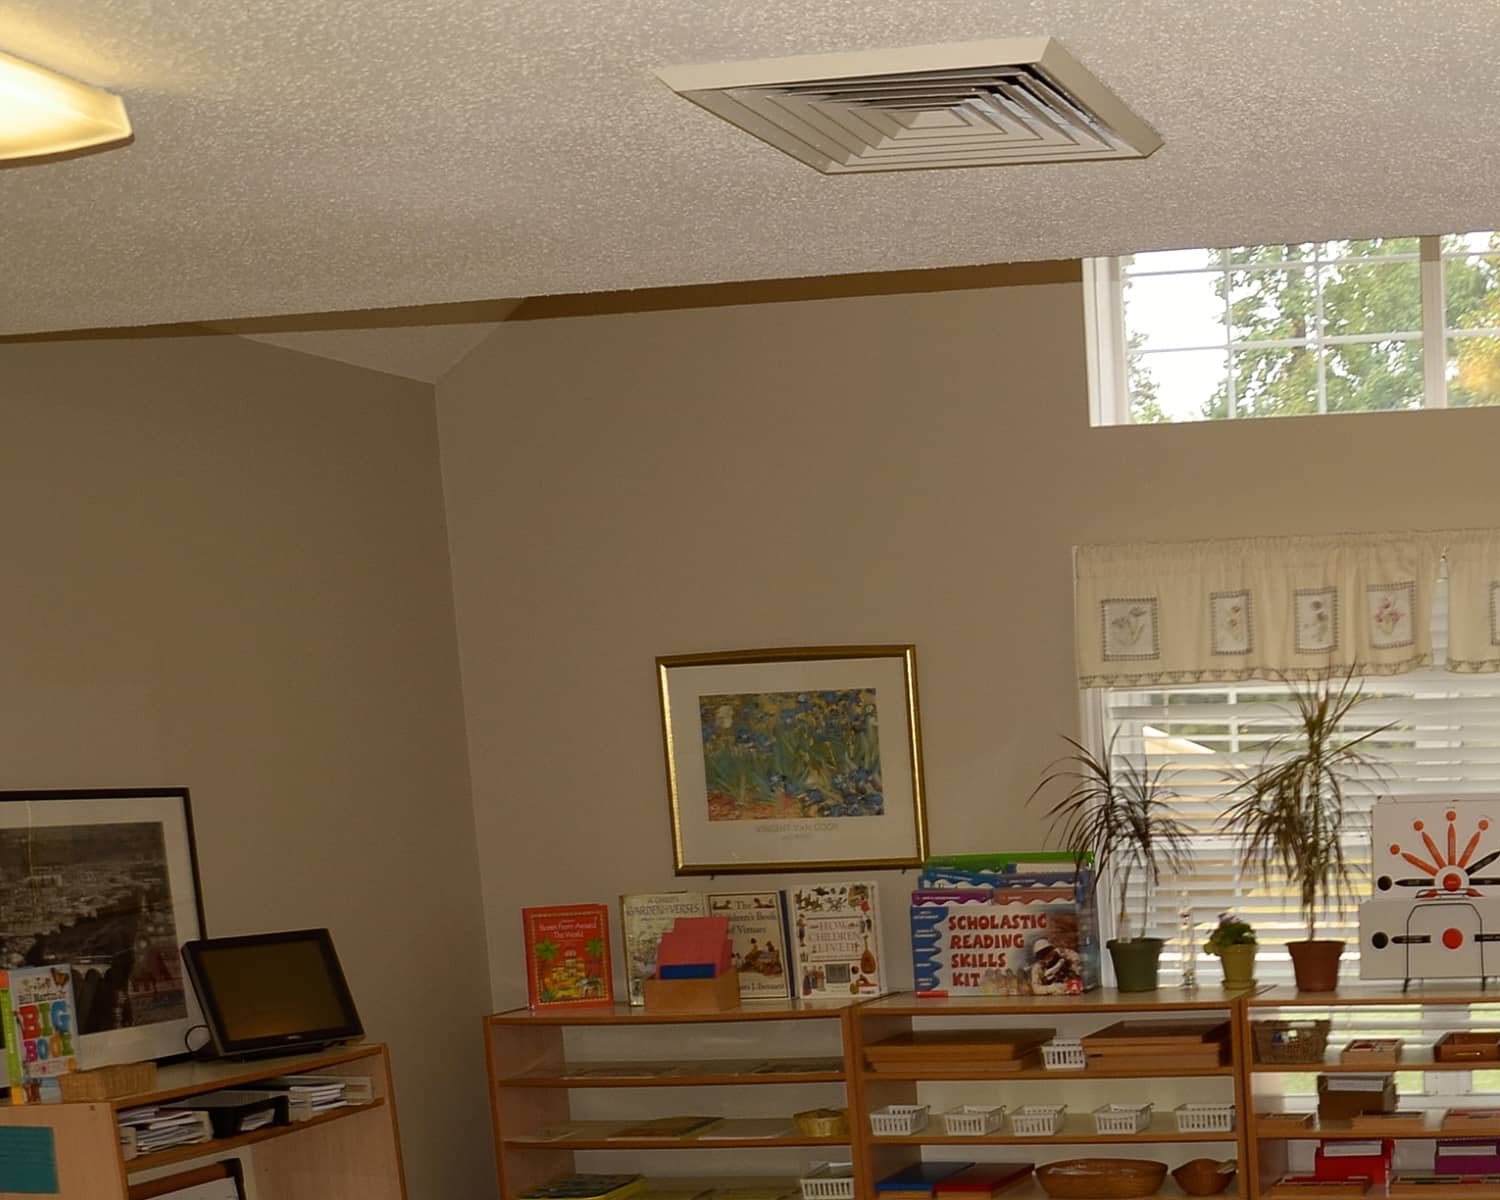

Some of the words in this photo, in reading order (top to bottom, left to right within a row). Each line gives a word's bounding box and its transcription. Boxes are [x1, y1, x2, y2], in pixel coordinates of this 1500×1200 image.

[671, 903, 700, 913] VERSES
[818, 921, 848, 930] HOW
[948, 912, 1048, 931] SCHOLASTIC
[808, 930, 862, 942] CHILDREN
[949, 933, 1025, 949] READING
[951, 952, 1006, 969] SKILLS
[952, 972, 981, 988] KIT
[19, 999, 71, 1040] BIG
[24, 1031, 75, 1063] BOOK
